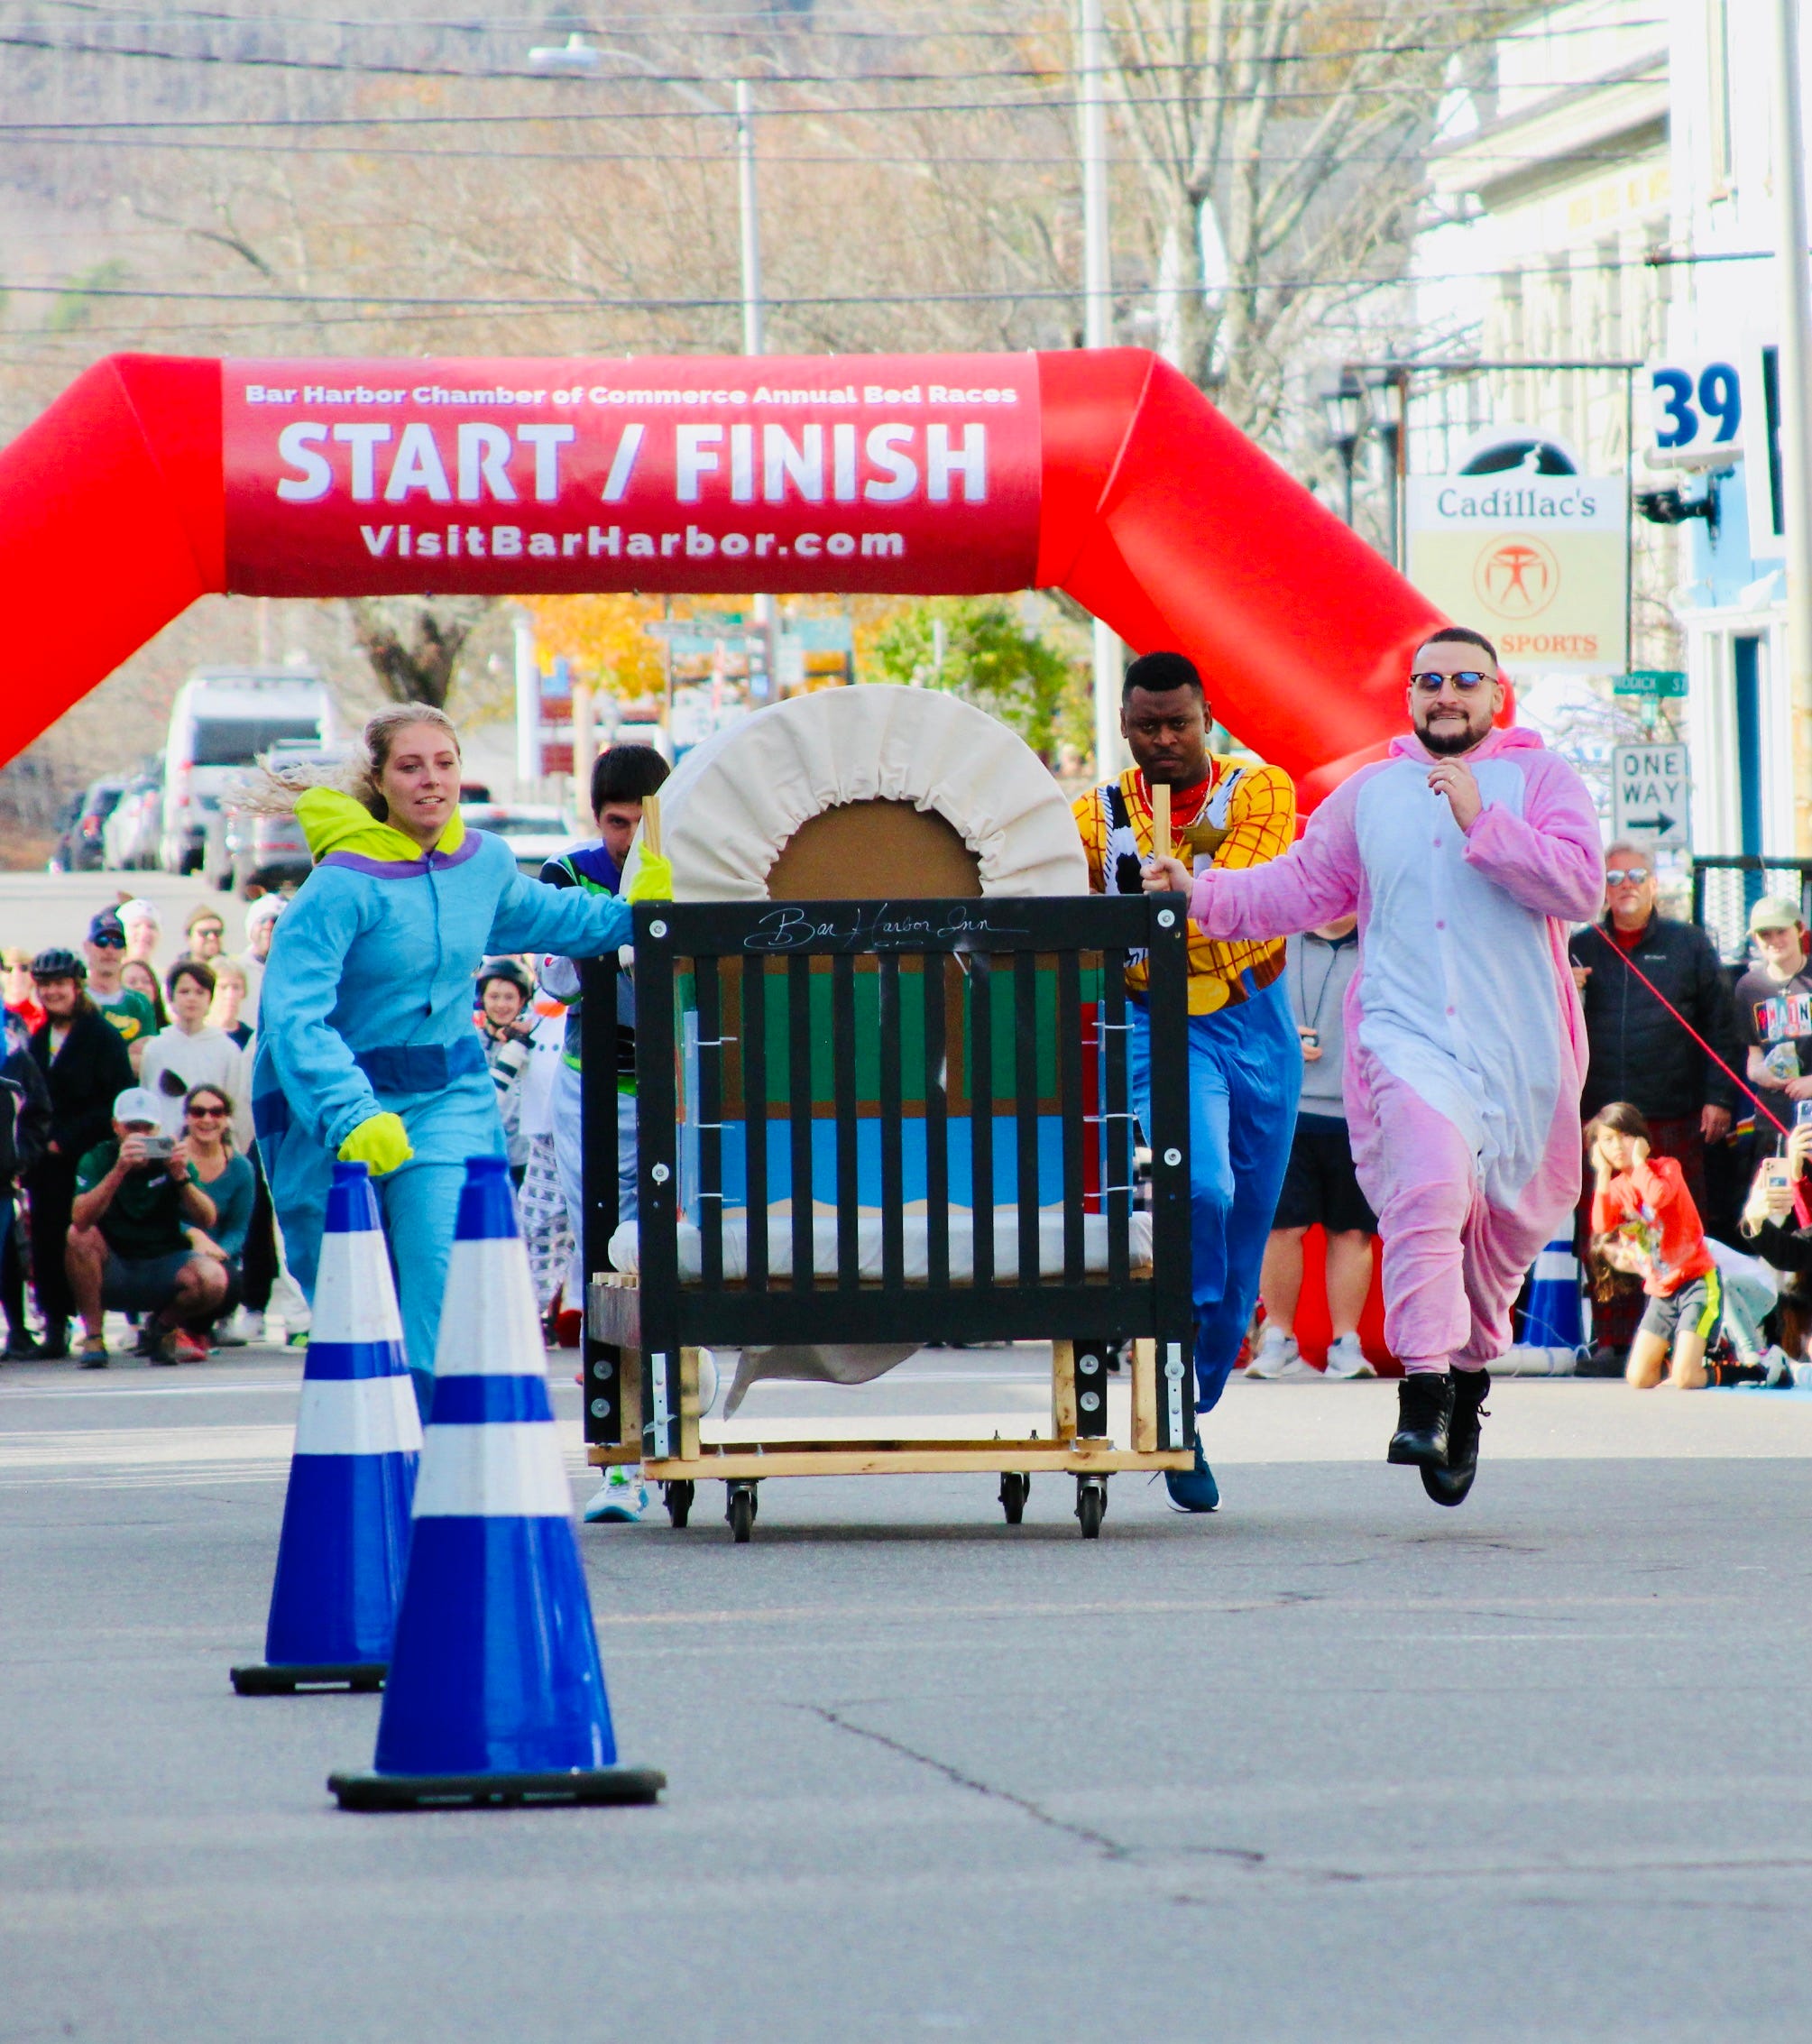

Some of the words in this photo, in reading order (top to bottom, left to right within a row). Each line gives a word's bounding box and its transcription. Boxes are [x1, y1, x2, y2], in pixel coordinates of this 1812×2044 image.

[245, 385, 298, 404] Bar
[303, 385, 406, 404] Harbor
[411, 385, 546, 405] Chamber
[551, 385, 582, 405] of
[588, 385, 748, 405] Commerce
[752, 385, 857, 405] Annual
[863, 385, 921, 404] Bed
[928, 385, 1017, 405] Races
[1652, 362, 1742, 447] 39
[276, 421, 575, 502] START
[601, 423, 645, 502] /
[675, 422, 987, 502] FINISH
[1436, 488, 1596, 518] Cadillac's
[360, 524, 904, 557] VisitBarHarbor.com
[1500, 633, 1597, 653] SPORTS
[1624, 752, 1679, 776] ONE
[1623, 780, 1679, 805] WAY
[743, 907, 837, 950] Bar
[842, 902, 933, 948] Harbor
[937, 905, 1030, 939] Inn
